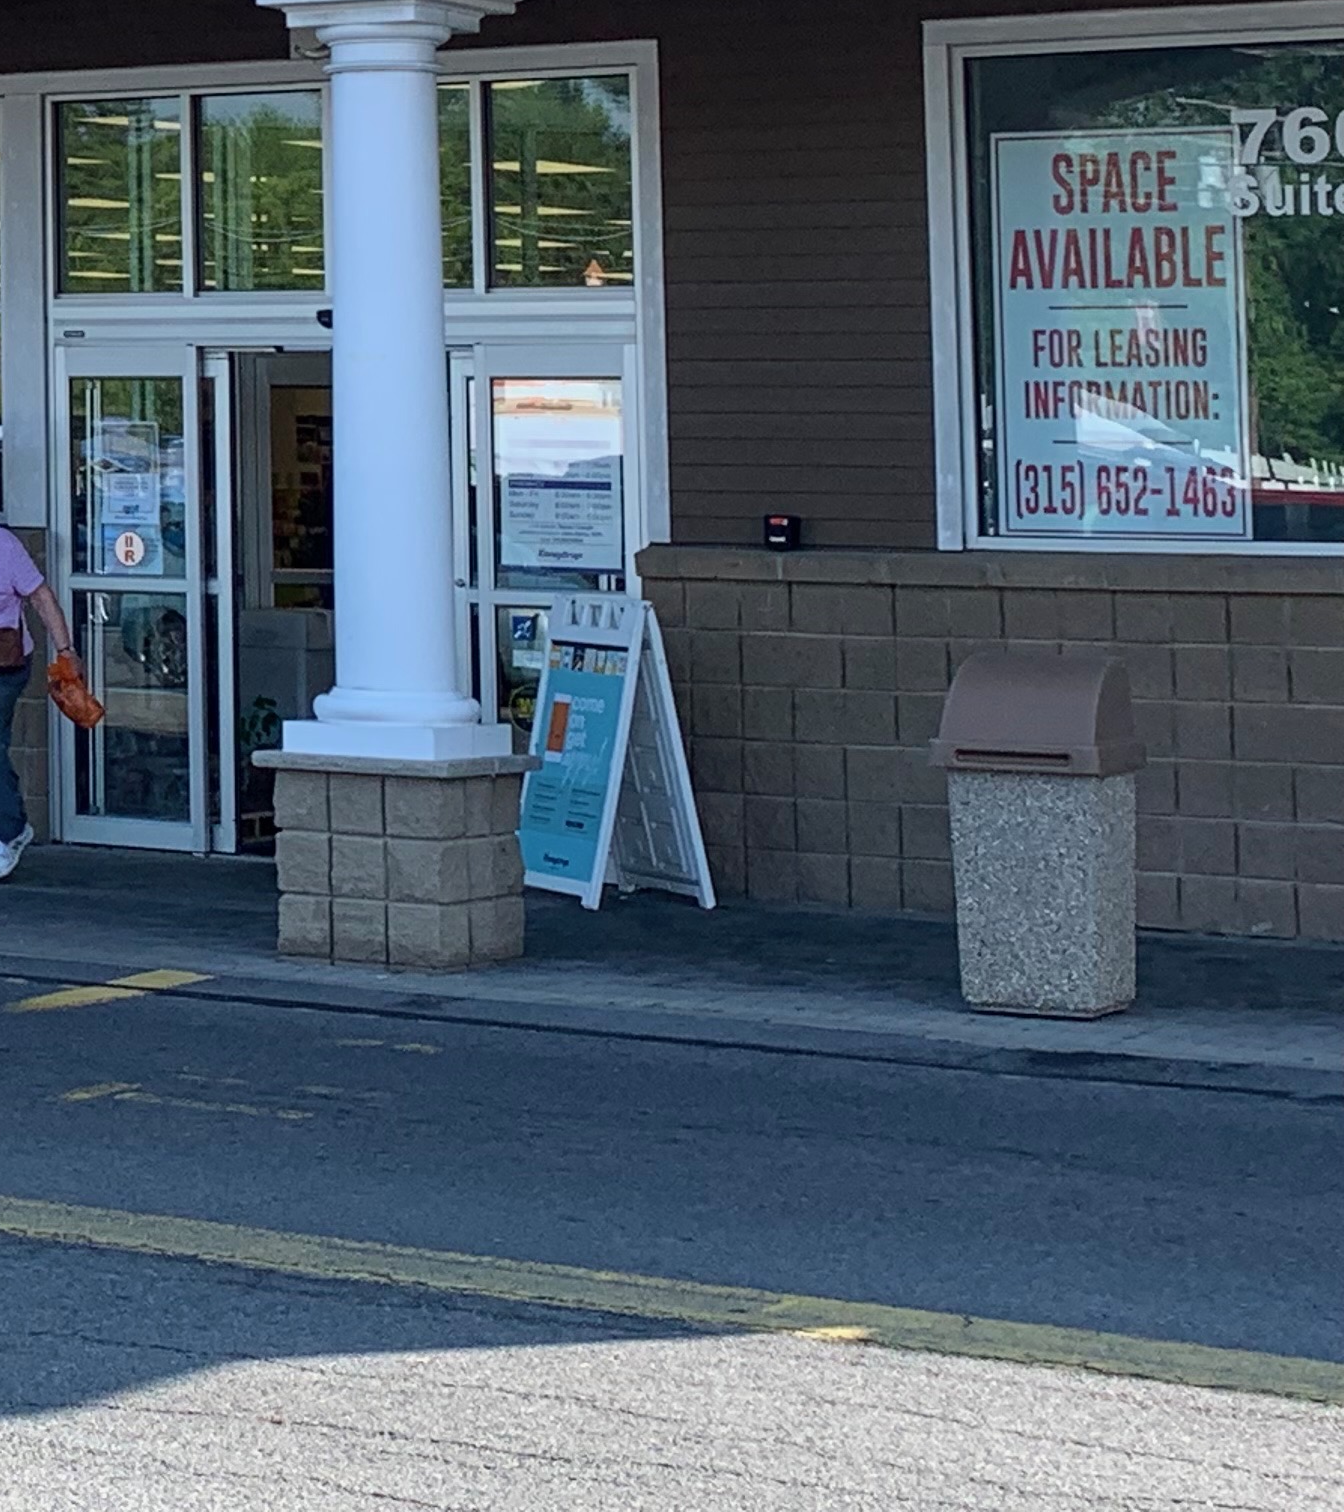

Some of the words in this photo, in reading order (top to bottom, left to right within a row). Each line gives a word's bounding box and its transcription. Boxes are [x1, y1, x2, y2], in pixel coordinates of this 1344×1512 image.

[1230, 106, 1344, 165] 76
[1052, 150, 1178, 216] SPACE
[1009, 224, 1227, 290] AVAILABLE
[1032, 329, 1083, 368] FOR
[1094, 327, 1208, 368] LEASING
[1024, 380, 1220, 421] INFORMATION:
[1015, 459, 1085, 520] (315)
[1096, 465, 1237, 518] 652-1463
